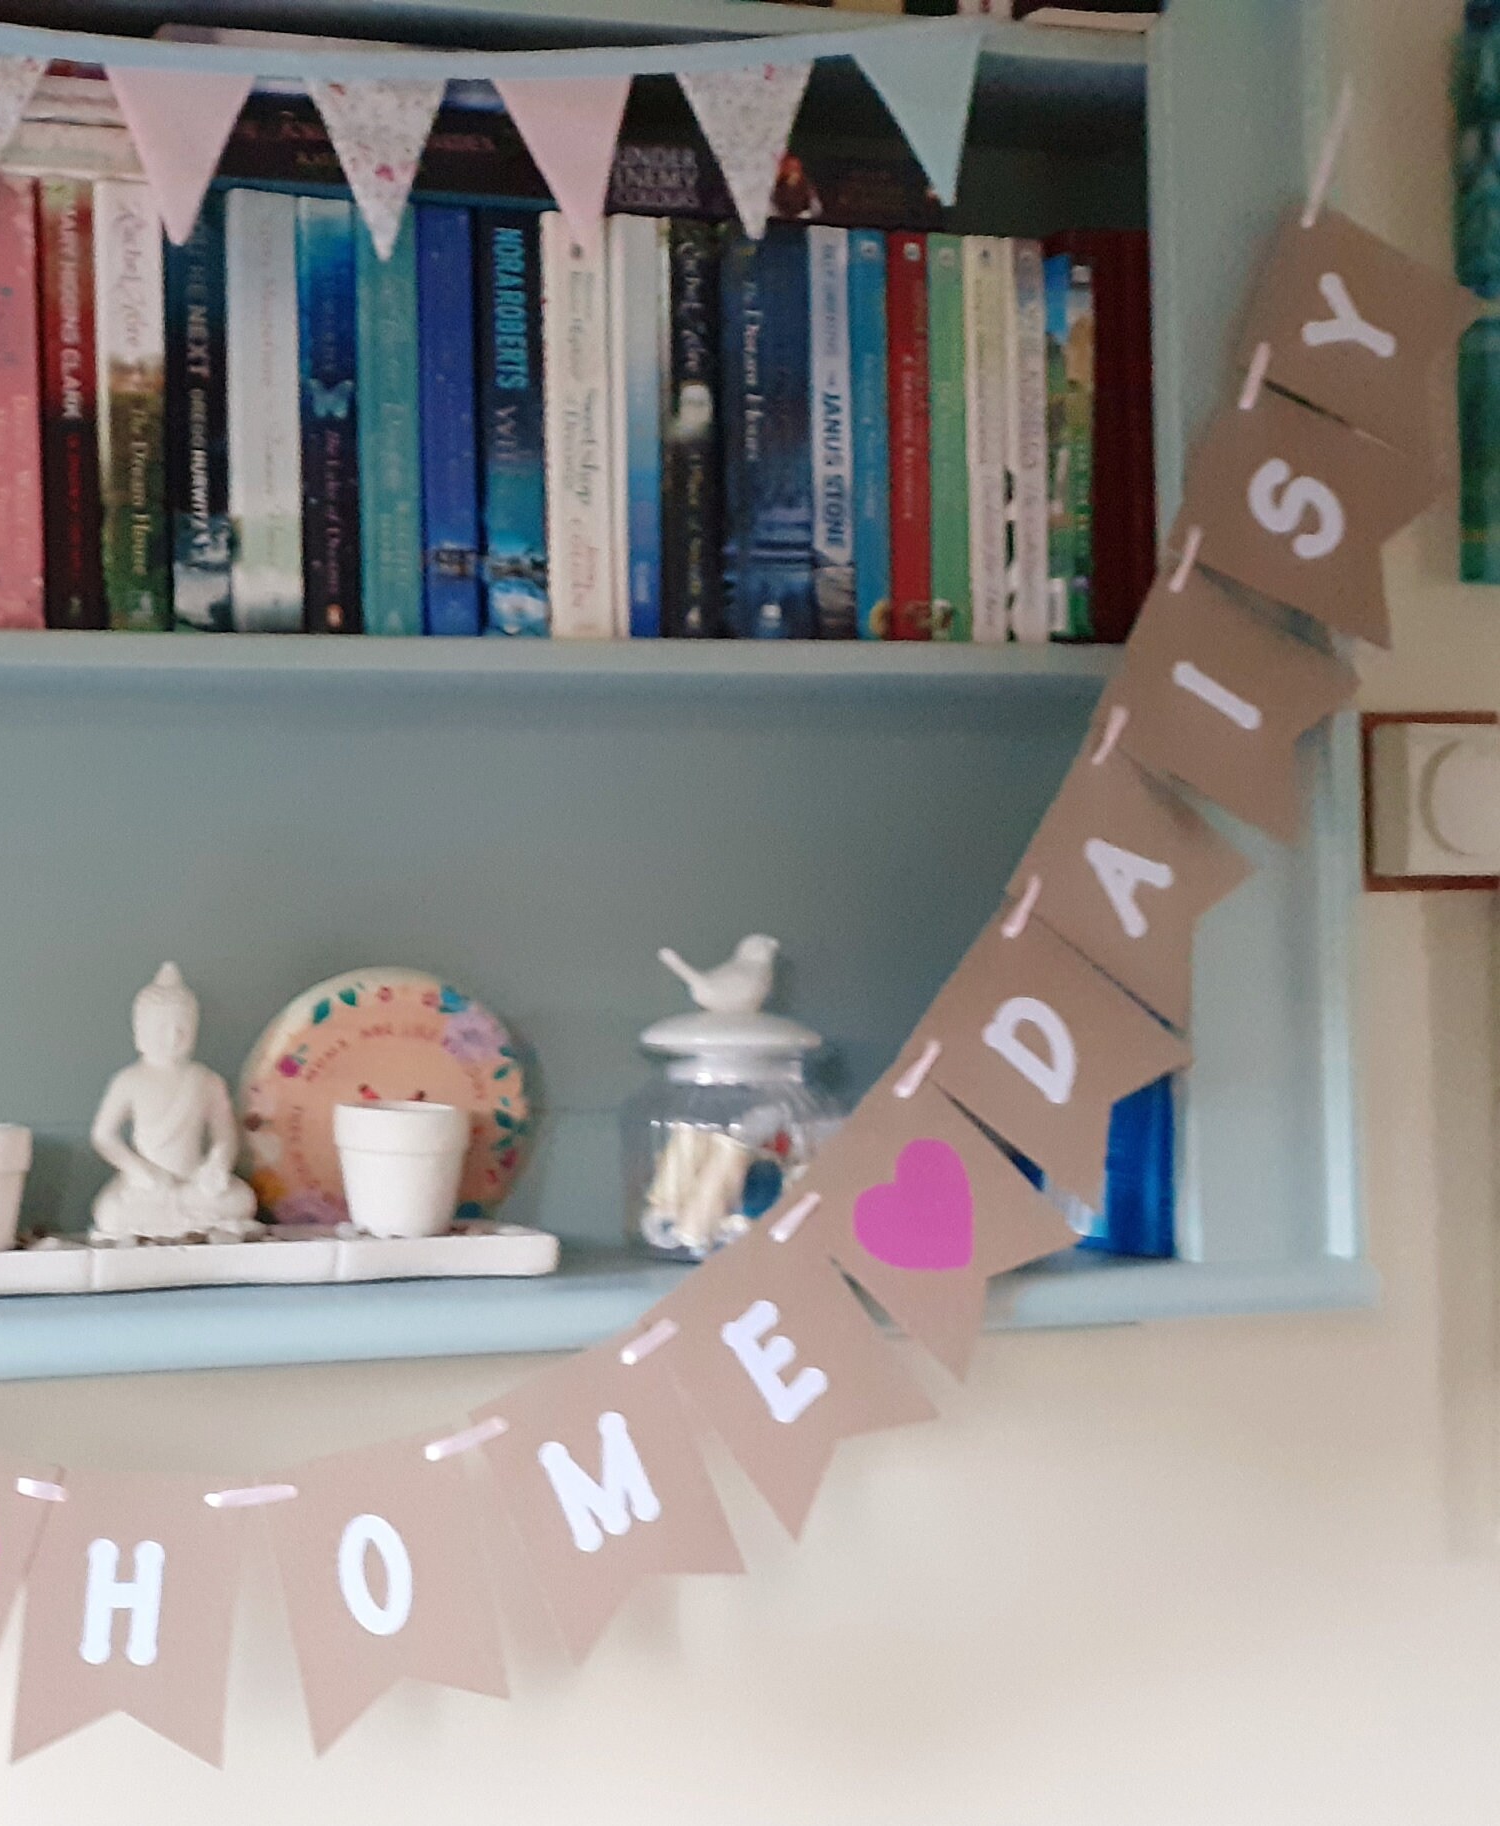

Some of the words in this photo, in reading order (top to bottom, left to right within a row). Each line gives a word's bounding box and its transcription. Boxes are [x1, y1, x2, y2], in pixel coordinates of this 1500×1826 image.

[491, 227, 526, 291] NORA
[59, 261, 81, 345] HIGGINS
[186, 304, 211, 379] NEXT
[493, 291, 531, 391] ROBERTS
[60, 347, 83, 419] CLARK
[822, 393, 844, 468] JANUS
[130, 440, 152, 507] Dream
[189, 449, 210, 531] HURWITZ
[130, 512, 154, 577] House
[823, 474, 847, 549] STONE
[78, 1299, 828, 1666] HOME
[982, 272, 1397, 1105] DAISY
